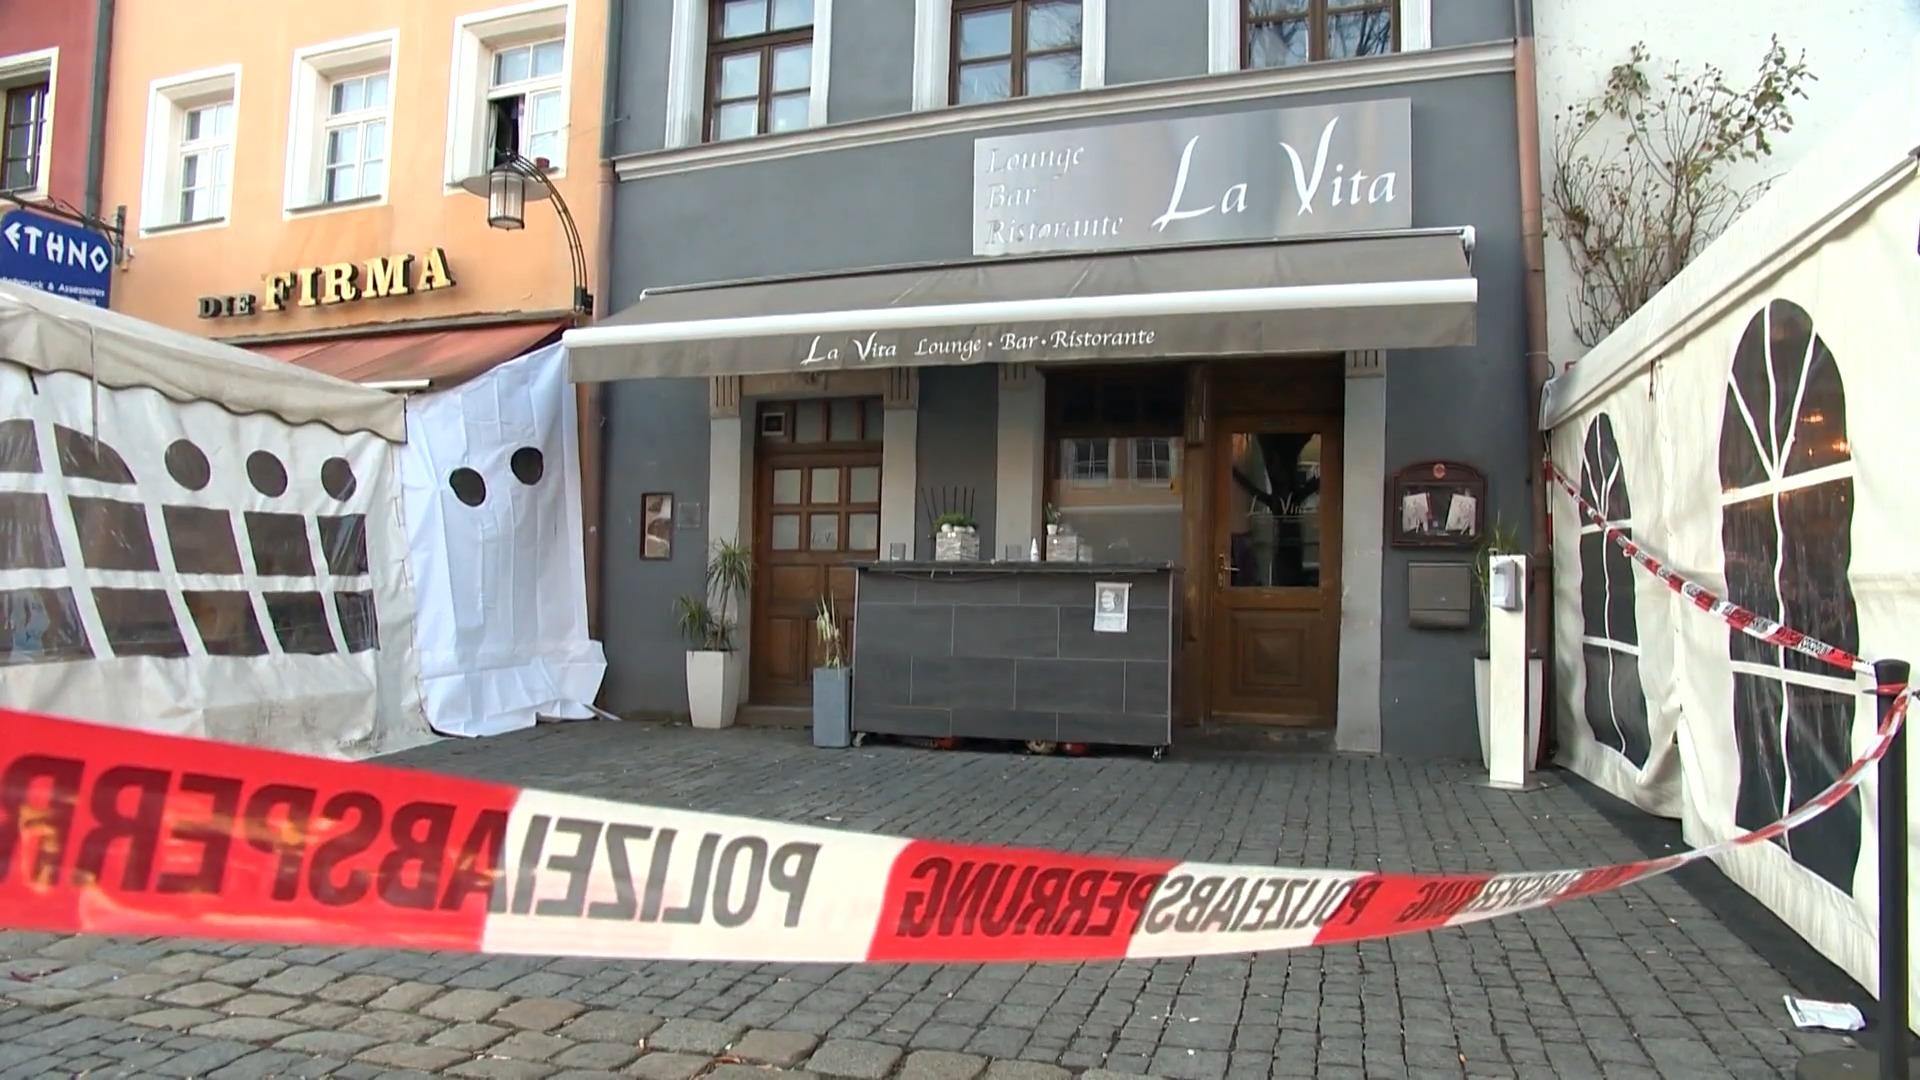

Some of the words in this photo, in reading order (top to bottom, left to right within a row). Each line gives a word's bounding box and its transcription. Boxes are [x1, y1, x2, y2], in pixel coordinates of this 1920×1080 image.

[986, 145, 1085, 180] Lounge
[1152, 135, 1248, 232] La
[1279, 116, 1397, 216] Vita
[985, 183, 1036, 209] Bar
[4, 221, 109, 274] ETHNO
[984, 216, 1124, 245] Ristorante
[198, 294, 256, 319] DIE
[262, 247, 457, 313] FIRMA
[800, 335, 839, 366] La
[852, 331, 897, 362] Vita
[914, 337, 982, 361] Lounge
[1000, 332, 1038, 351] Bar
[1050, 329, 1156, 349] Ristorante
